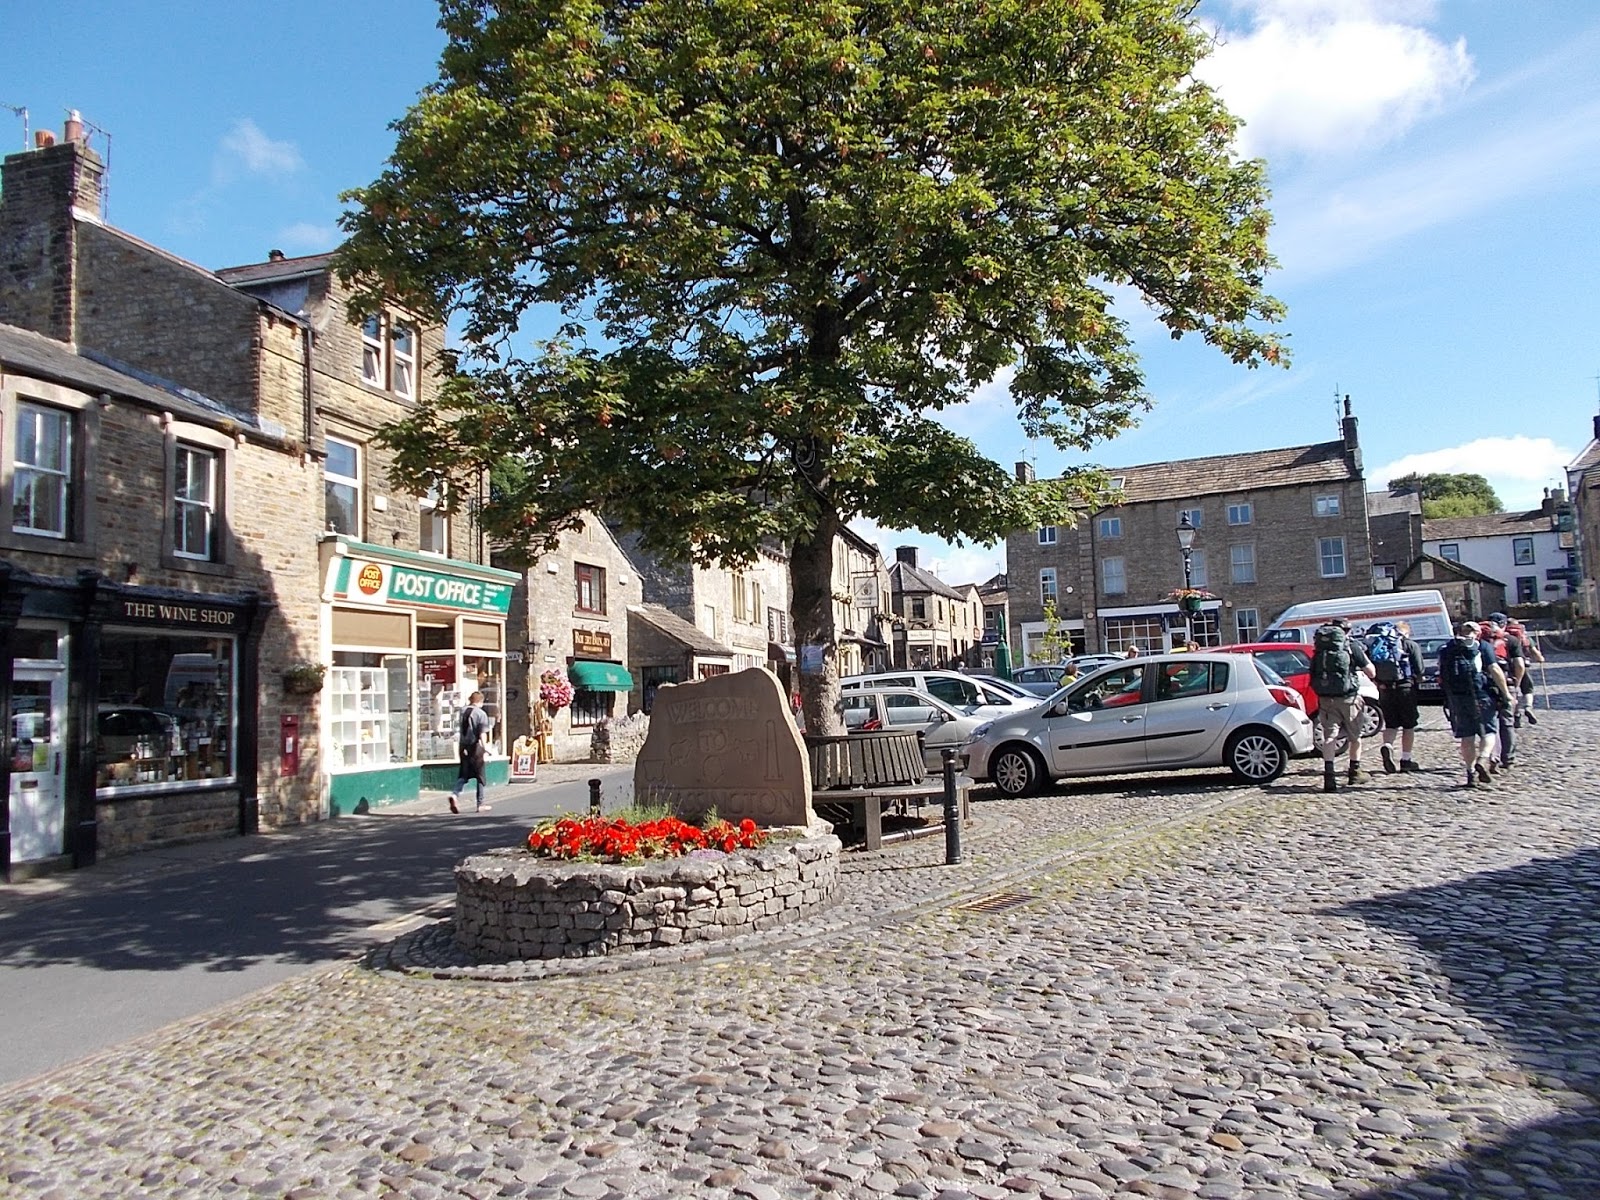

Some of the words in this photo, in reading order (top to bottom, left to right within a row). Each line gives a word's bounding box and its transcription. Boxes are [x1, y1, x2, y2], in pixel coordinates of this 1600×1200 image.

[359, 578, 381, 589] OFFICE
[364, 569, 380, 580] POST
[393, 572, 435, 598] POST
[434, 578, 482, 605] OFFICE
[124, 602, 156, 618] THE
[159, 605, 198, 622] WINE
[200, 609, 235, 625] SHOP
[666, 697, 760, 723] WELCOME
[699, 729, 728, 752] TO
